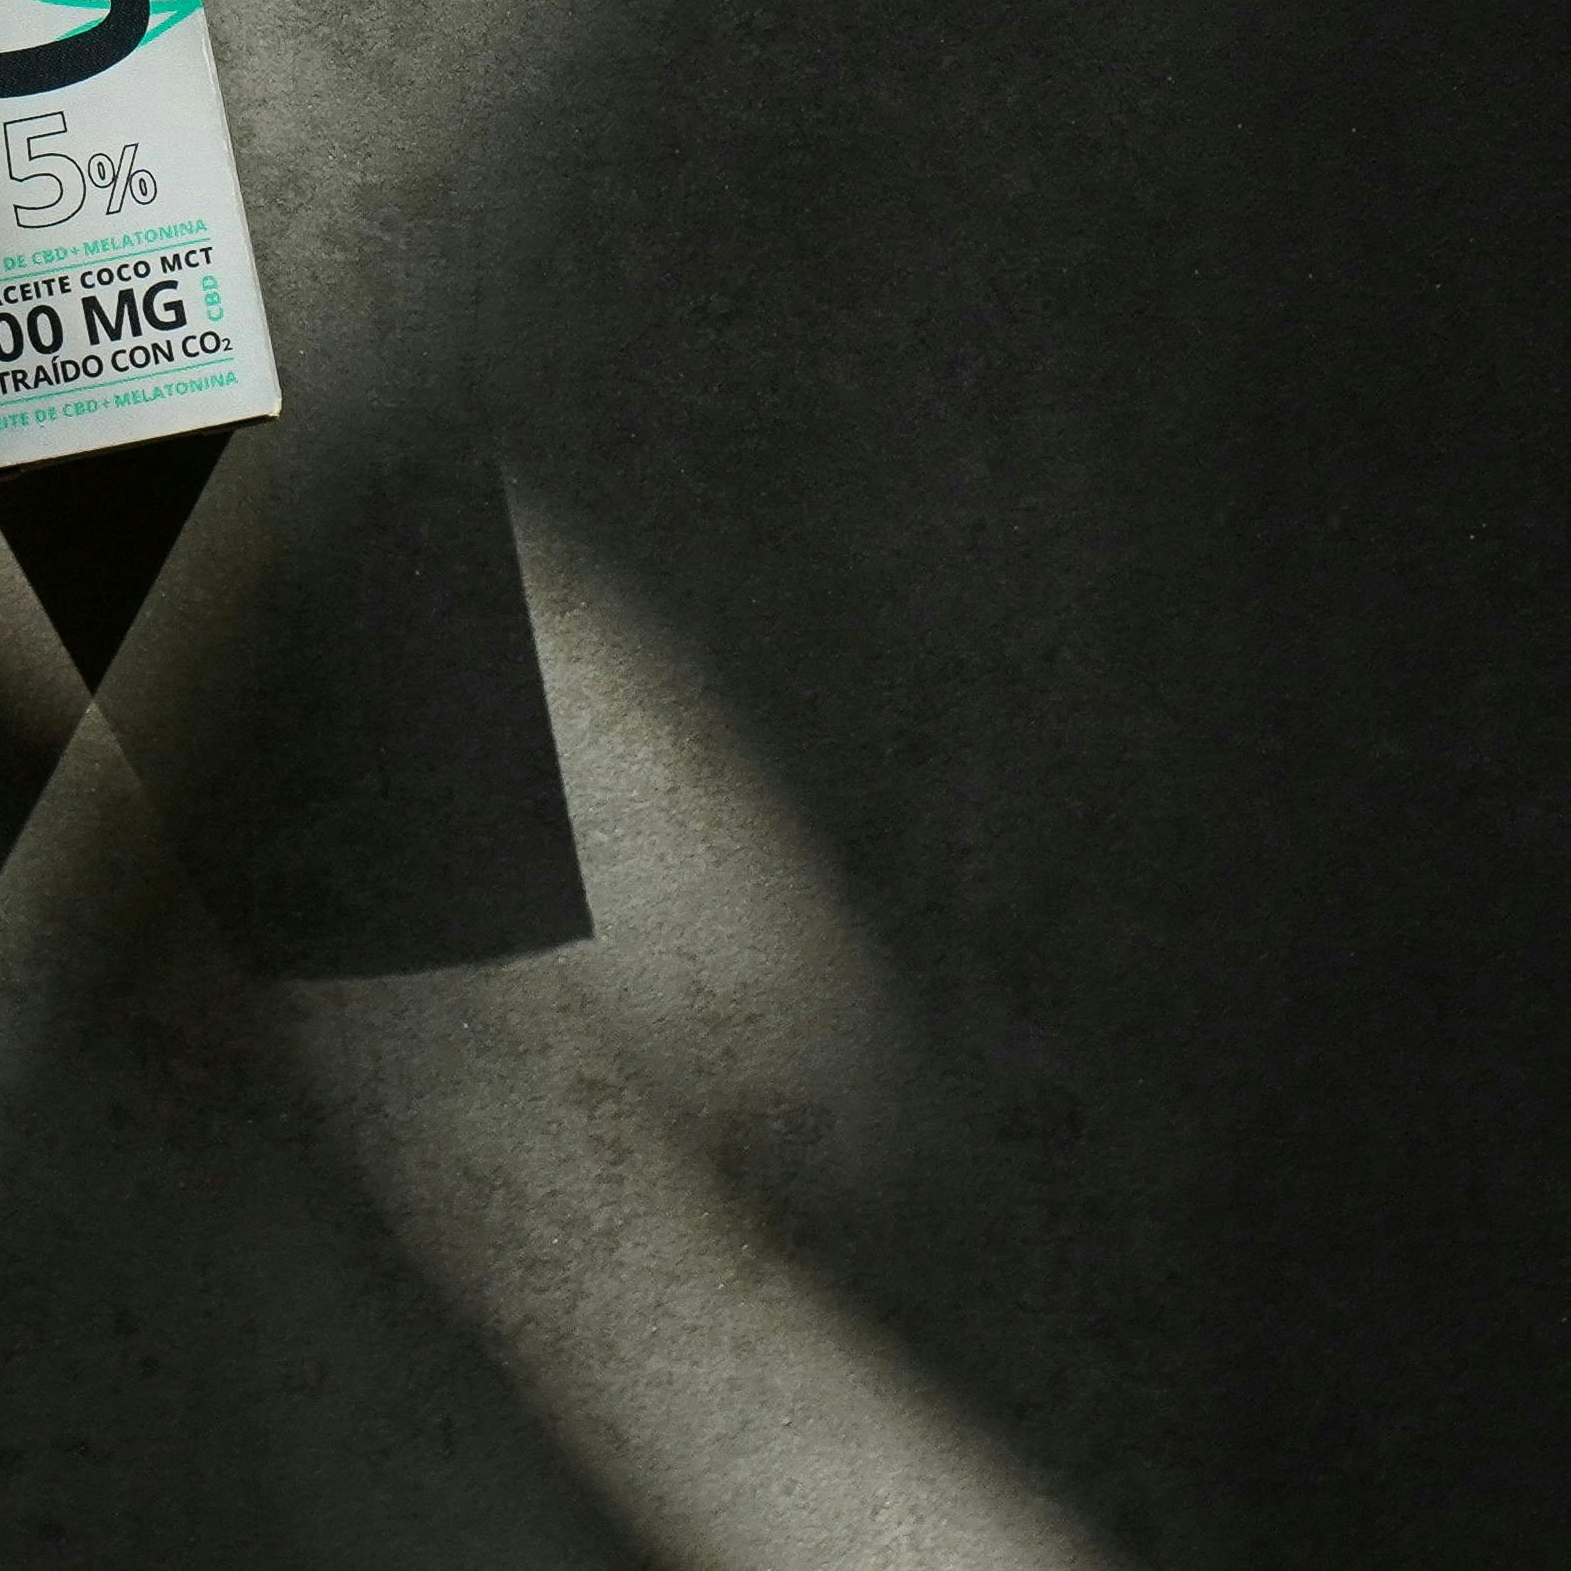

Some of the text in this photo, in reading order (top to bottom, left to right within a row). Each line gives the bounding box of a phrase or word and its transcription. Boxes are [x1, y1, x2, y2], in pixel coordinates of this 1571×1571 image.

[2, 110, 158, 229] 5%
[2, 254, 28, 272] DE
[80, 260, 151, 290] COCO
[159, 246, 213, 274] MCT
[81, 279, 188, 347] MG
[201, 274, 225, 323] CBD
[110, 339, 175, 373] CON
[34, 406, 59, 423] DE
